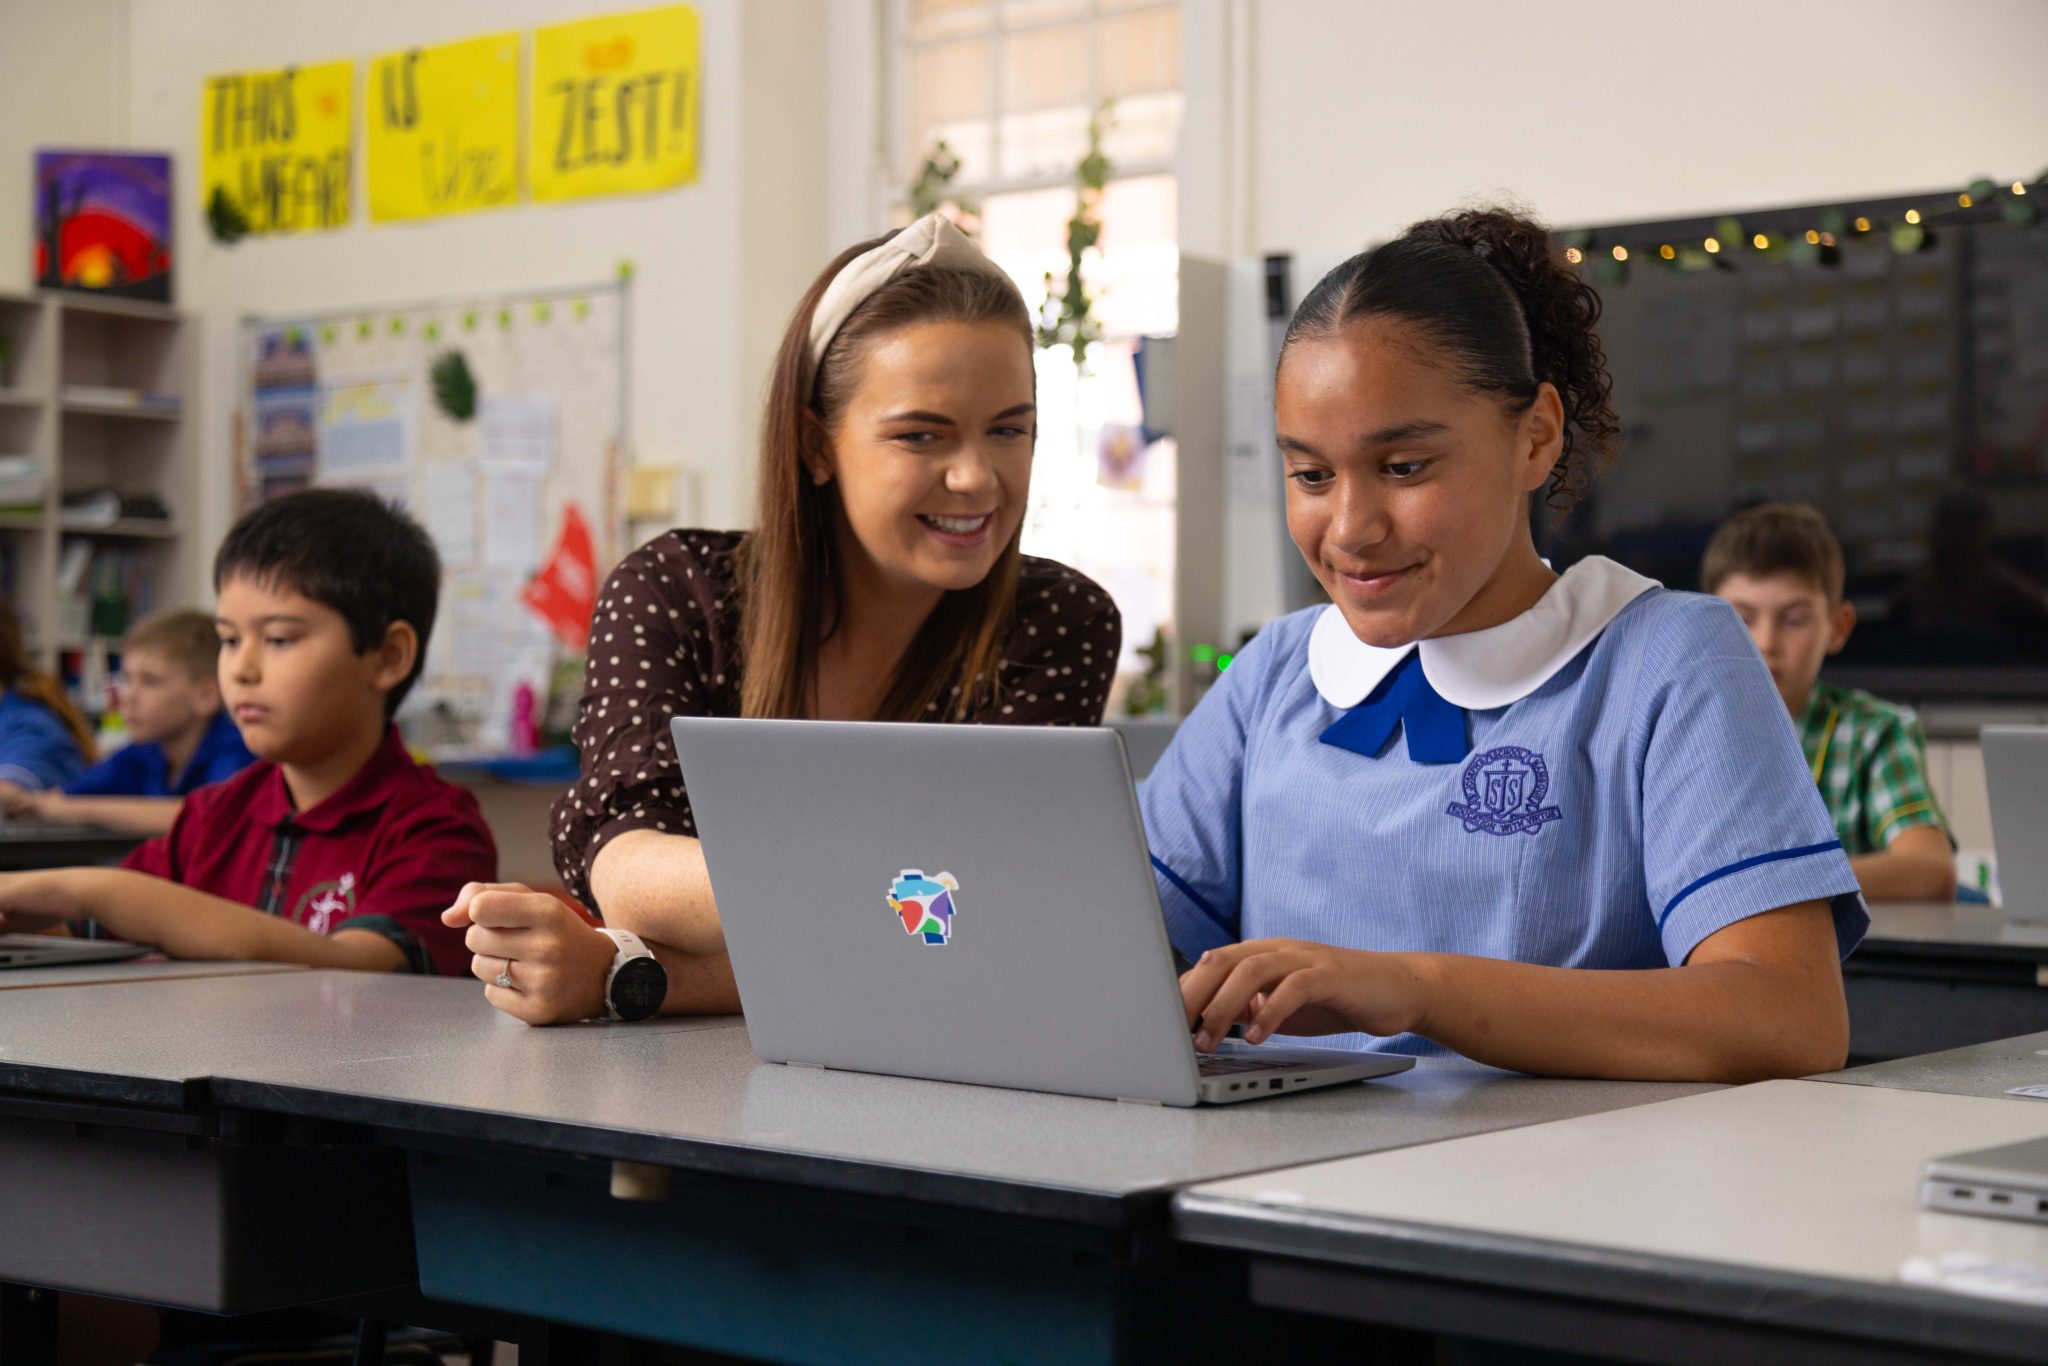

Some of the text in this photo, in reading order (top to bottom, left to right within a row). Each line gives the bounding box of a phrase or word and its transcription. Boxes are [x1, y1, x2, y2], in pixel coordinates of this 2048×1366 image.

[206, 68, 300, 156] THIS
[382, 47, 421, 131] IS
[551, 66, 691, 173] ZEST!
[1501, 819, 1523, 832] WITH
